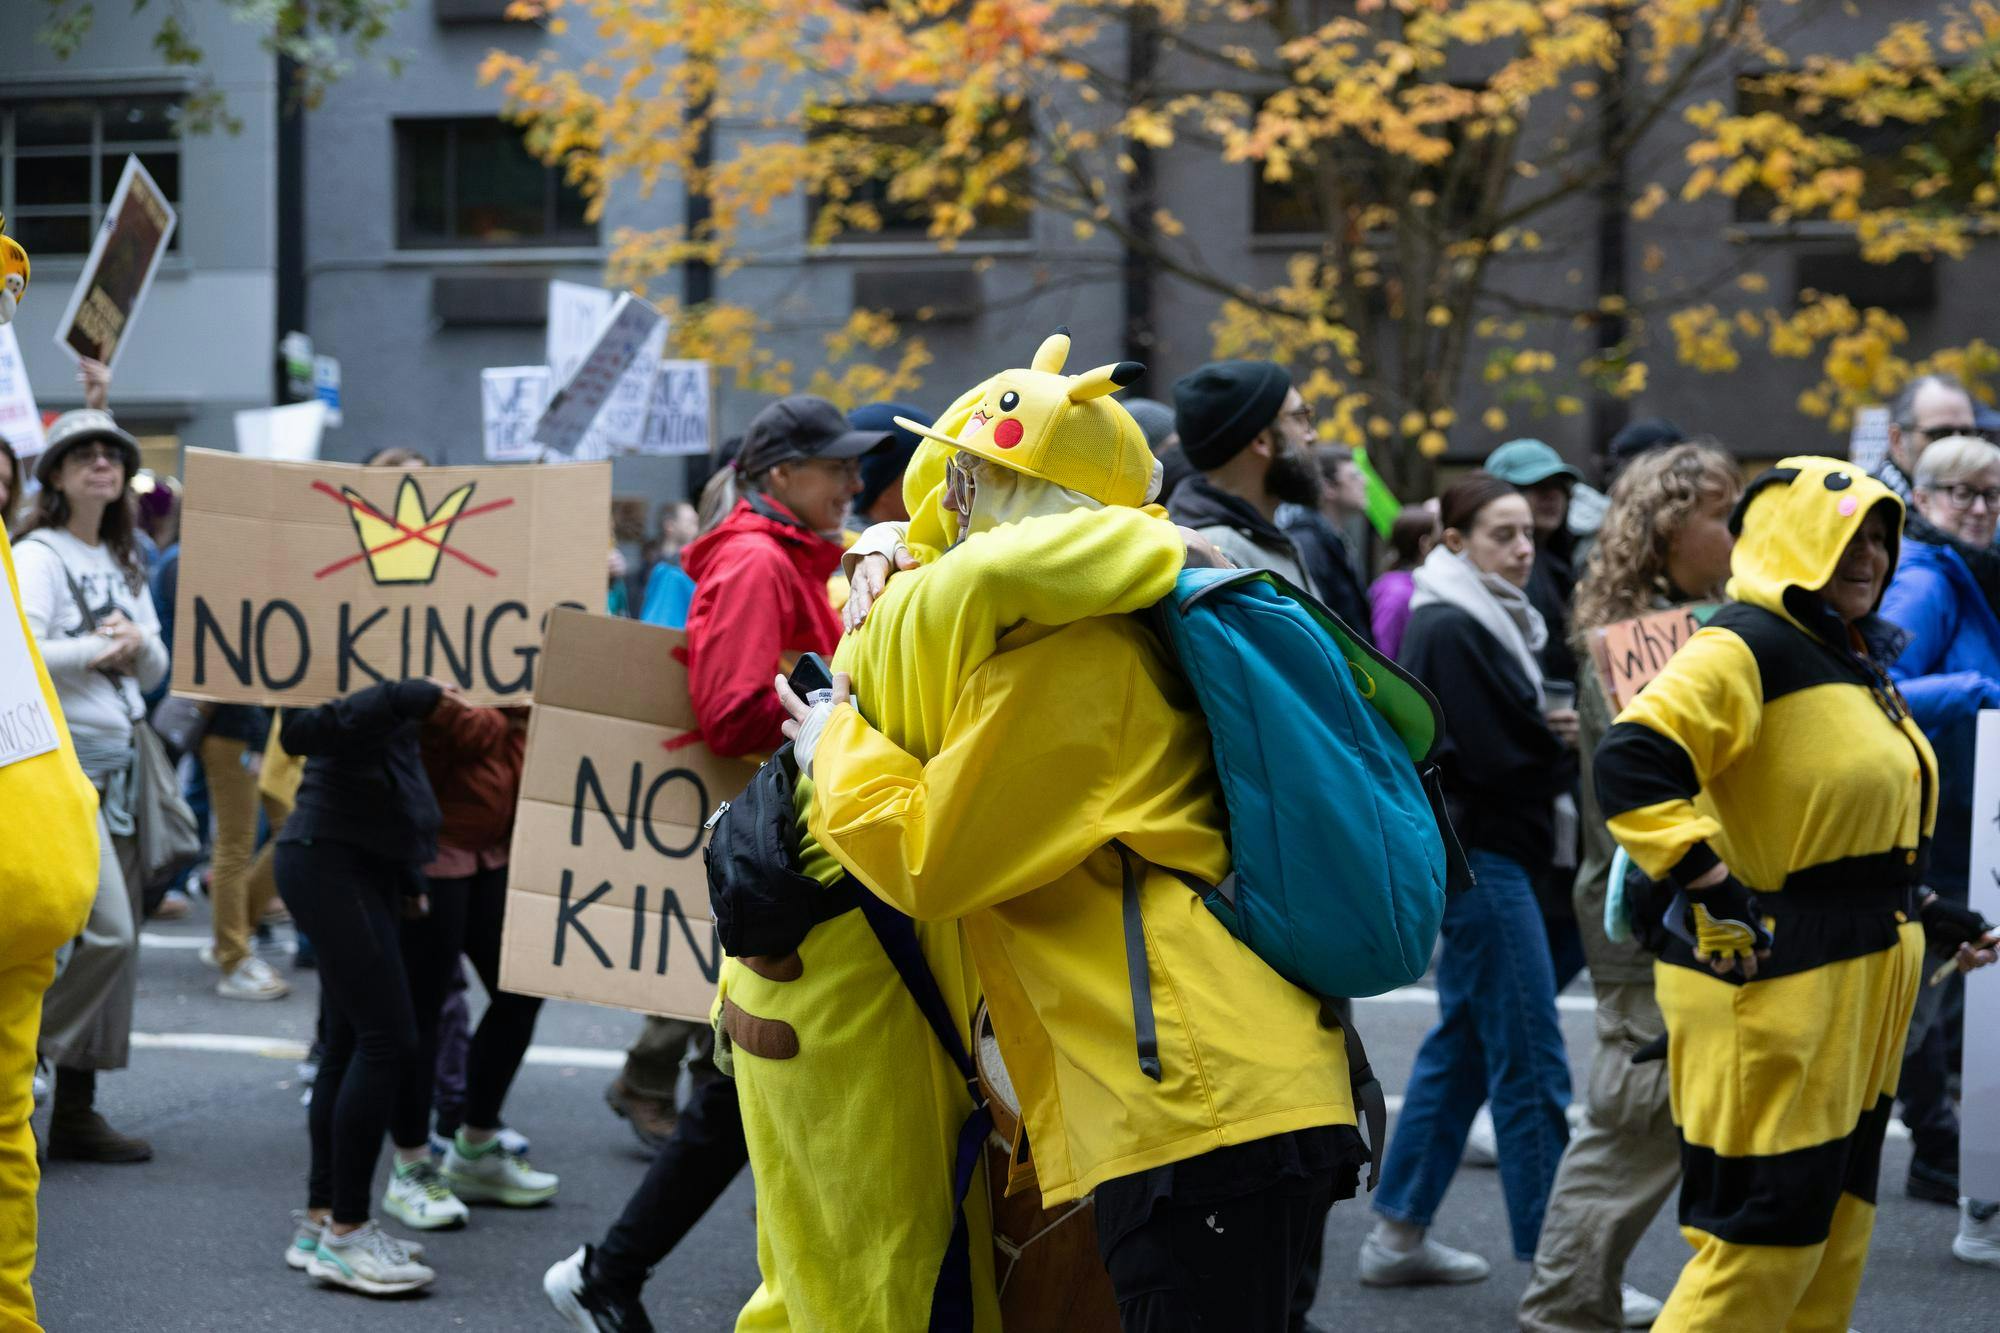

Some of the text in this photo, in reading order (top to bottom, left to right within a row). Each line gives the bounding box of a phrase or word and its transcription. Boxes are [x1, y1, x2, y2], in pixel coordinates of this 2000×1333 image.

[194, 595, 587, 694] NO KING
[571, 756, 709, 858] NO
[552, 869, 719, 984] KIN
